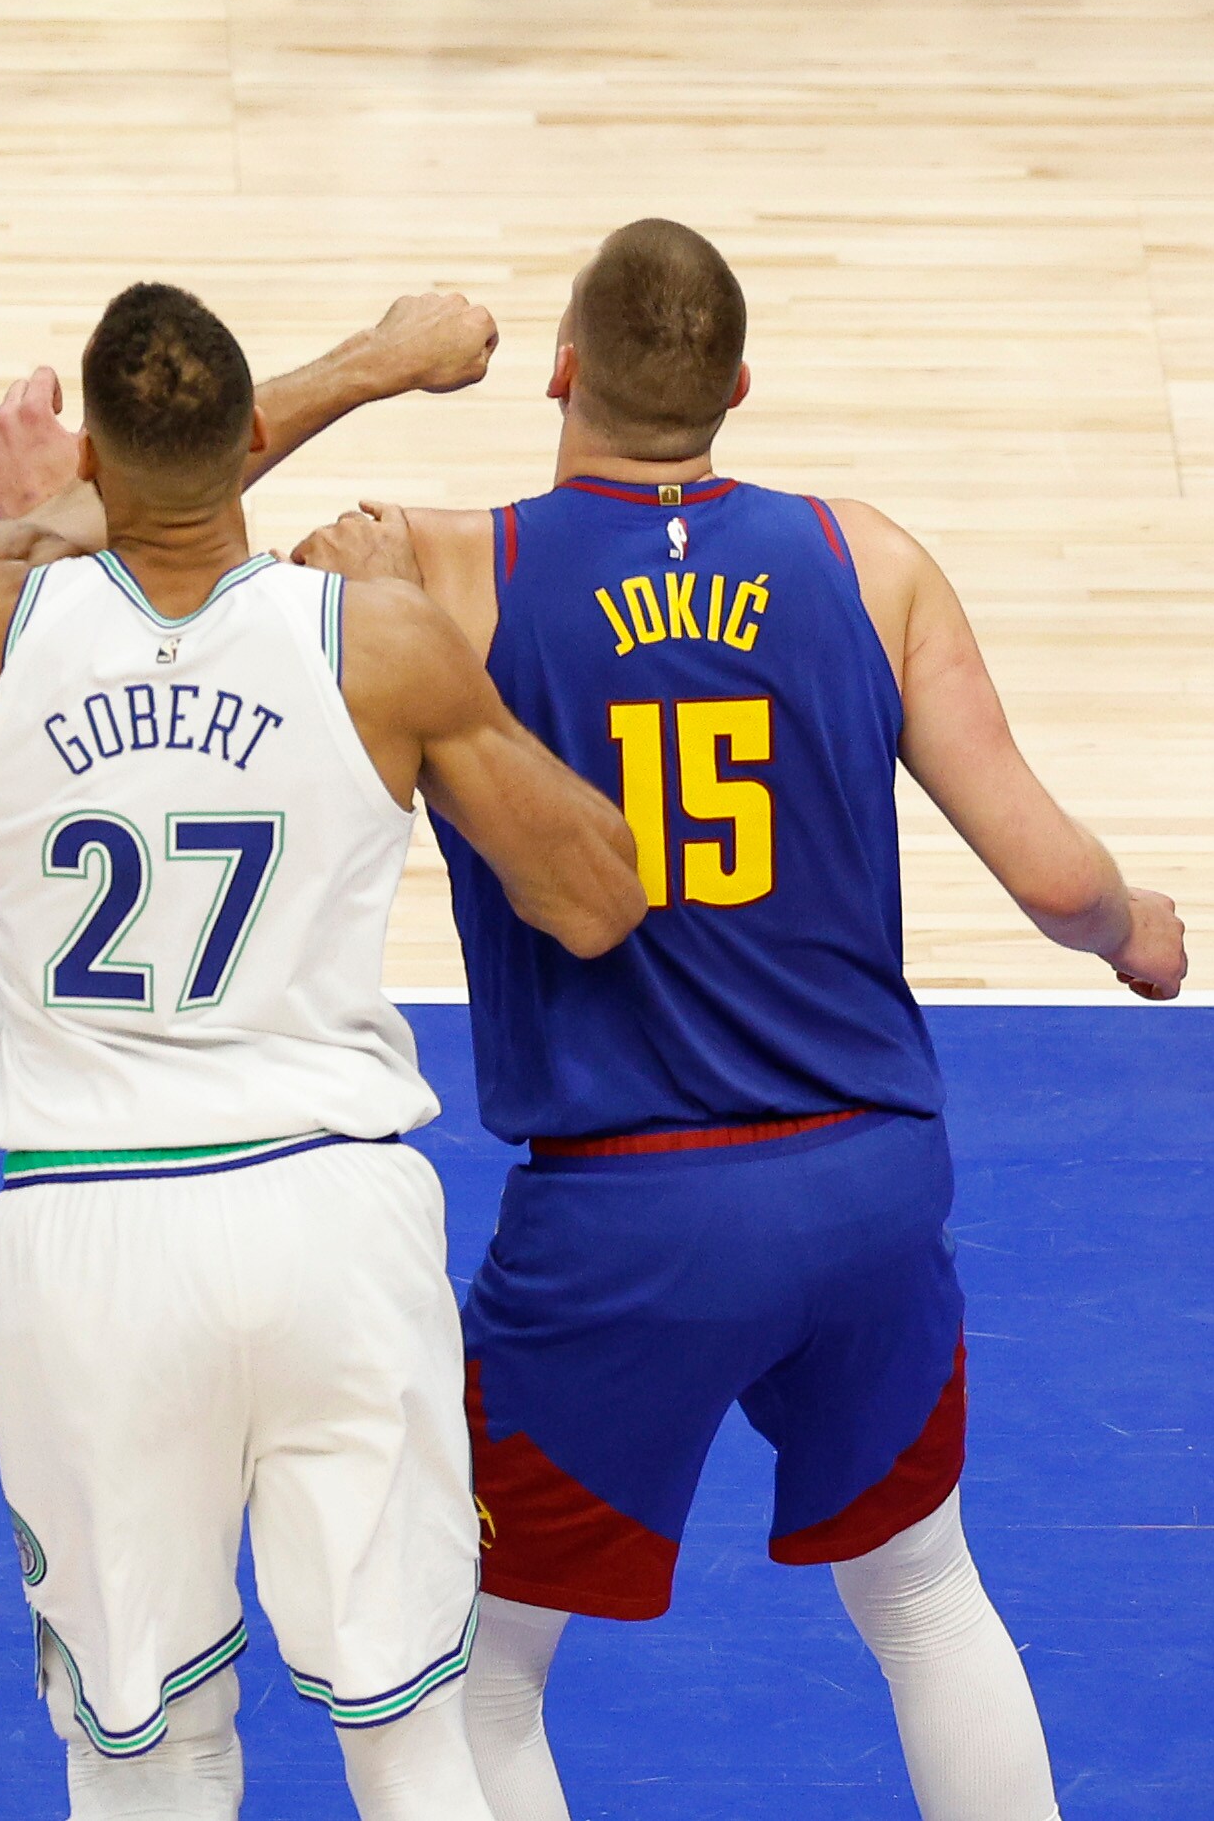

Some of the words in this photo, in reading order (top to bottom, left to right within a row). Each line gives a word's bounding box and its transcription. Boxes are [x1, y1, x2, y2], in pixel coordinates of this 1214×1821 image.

[594, 572, 770, 657] JOKIĆ
[44, 683, 284, 776] GOBERT
[606, 696, 776, 910] 15
[42, 808, 285, 1013] 27
